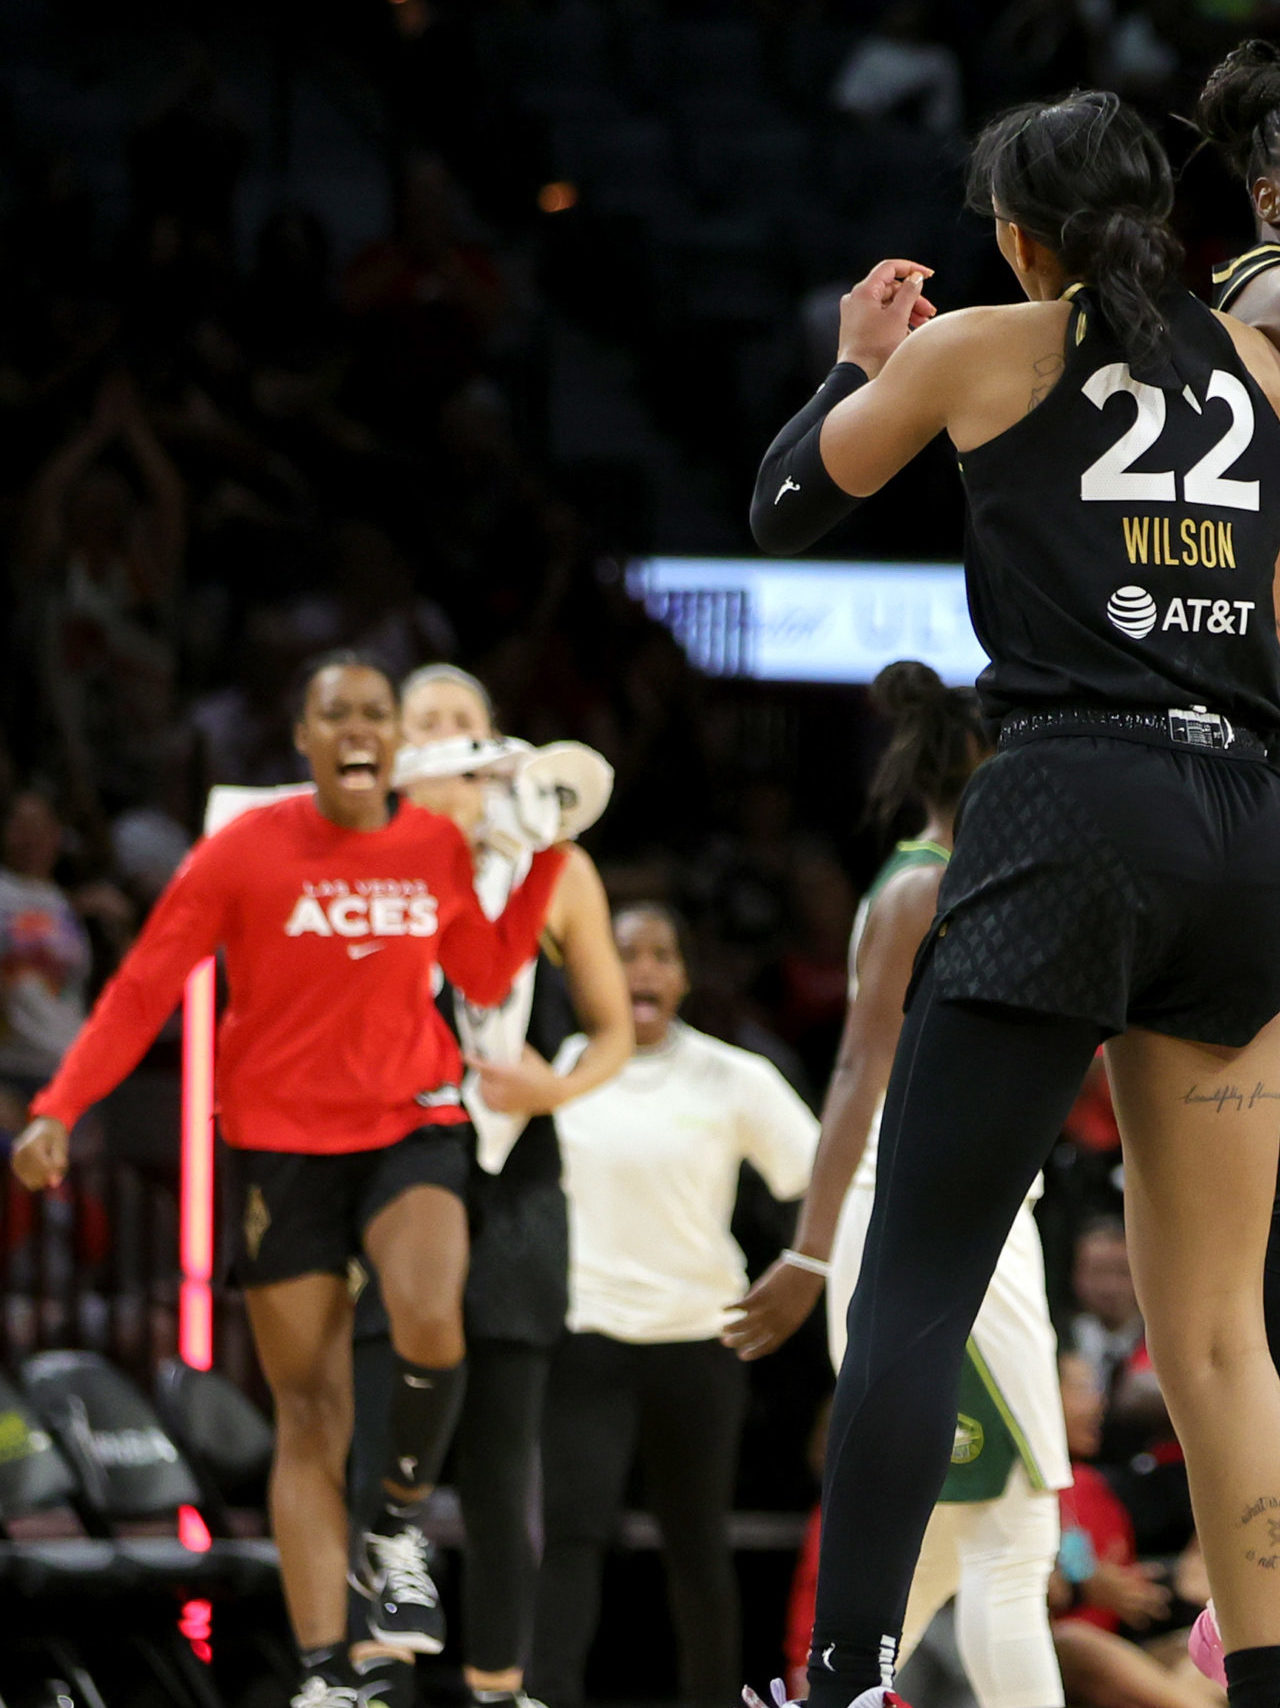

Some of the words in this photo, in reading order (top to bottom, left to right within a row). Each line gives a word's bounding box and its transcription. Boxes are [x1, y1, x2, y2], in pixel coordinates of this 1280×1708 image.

[1080, 362, 1260, 512] 22
[1122, 516, 1236, 569] WILSON
[1161, 597, 1256, 636] AT&T
[284, 893, 440, 937] ACES
